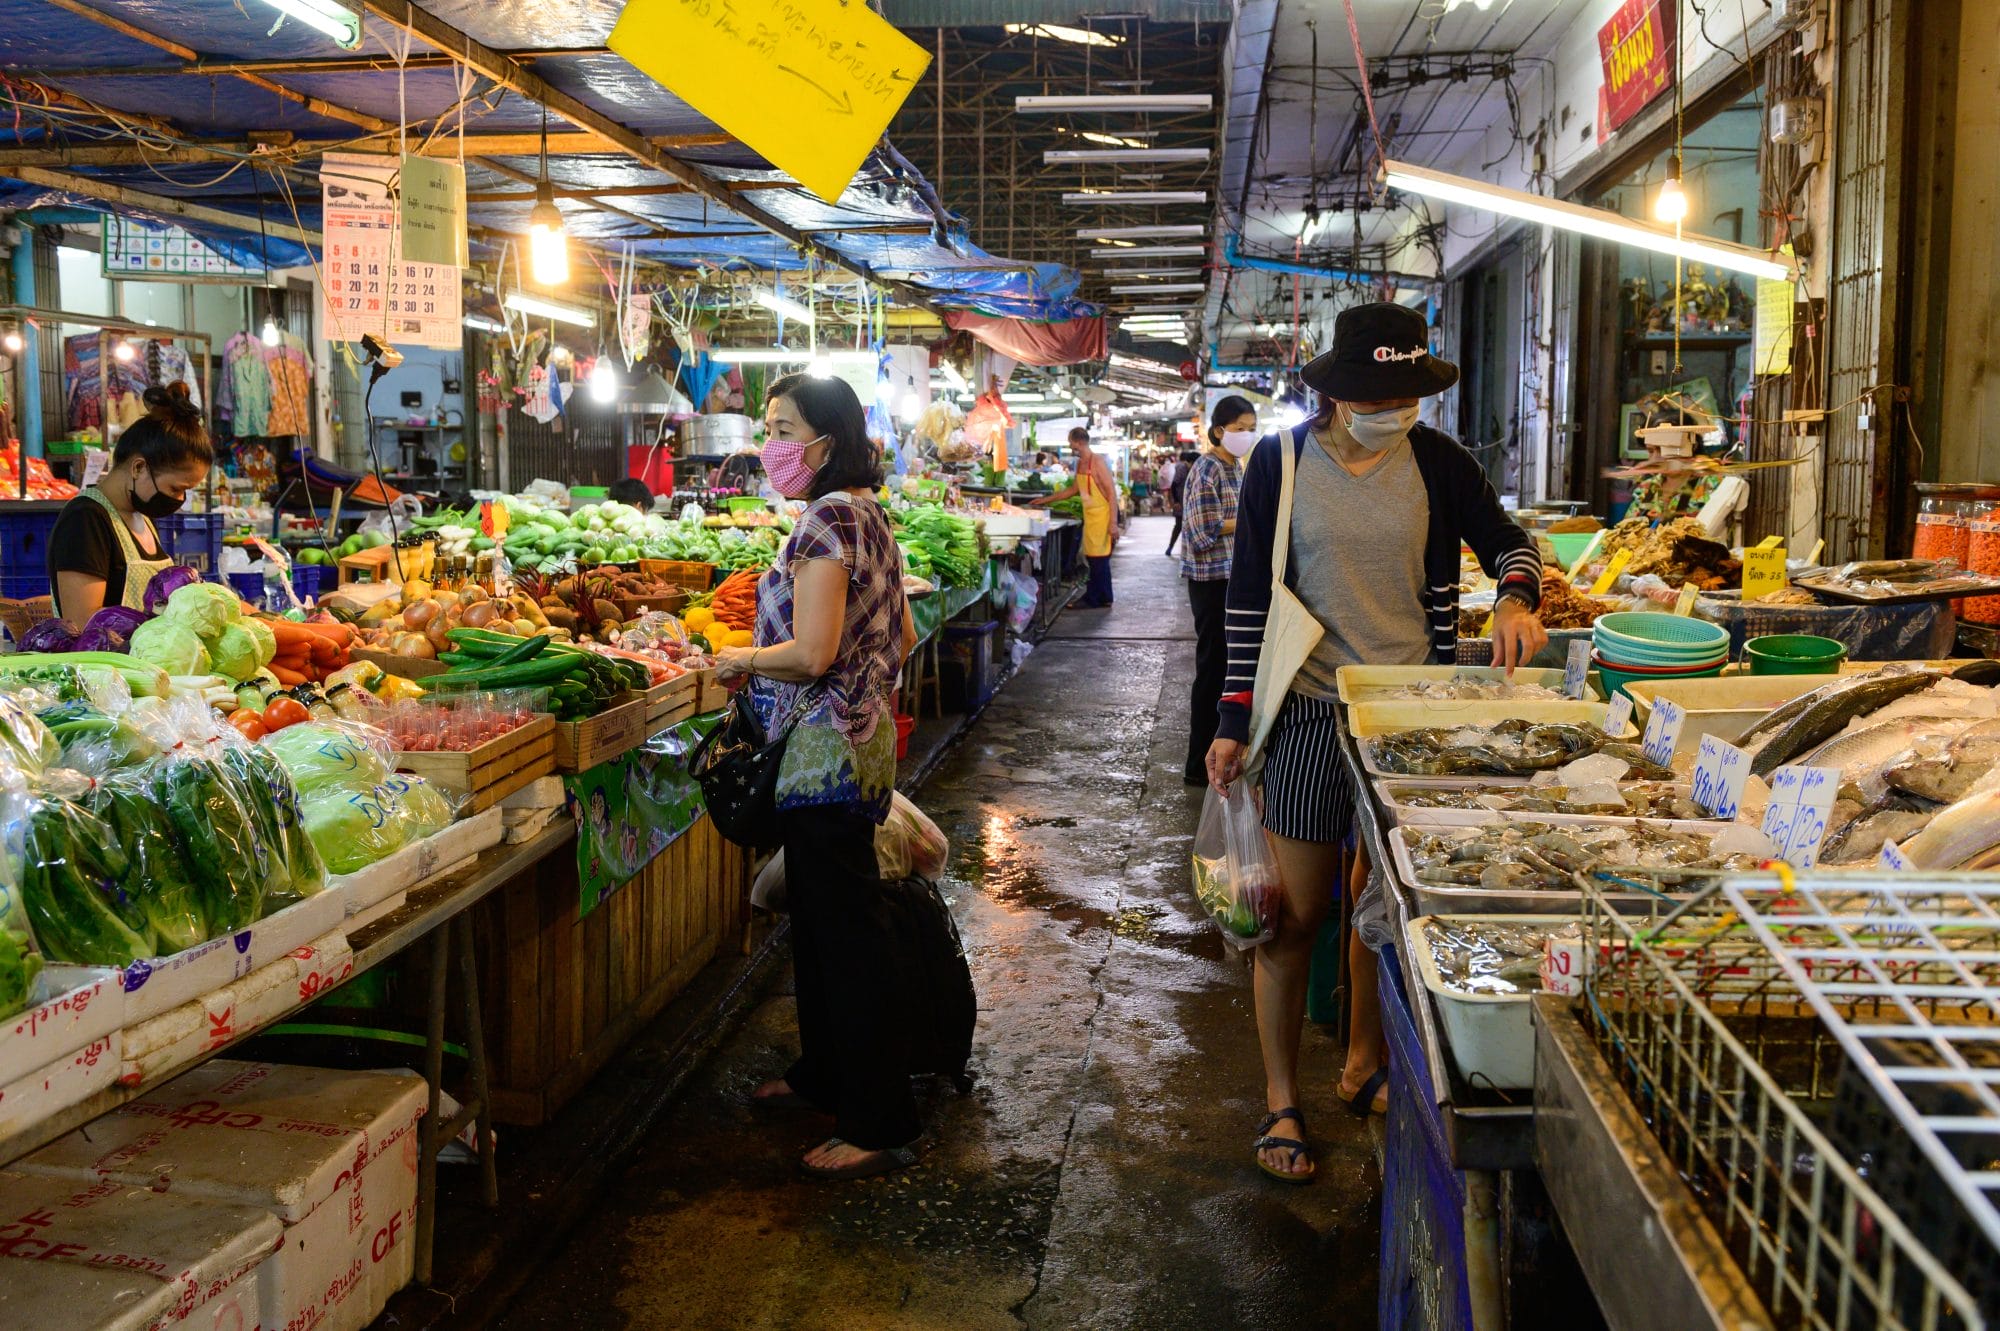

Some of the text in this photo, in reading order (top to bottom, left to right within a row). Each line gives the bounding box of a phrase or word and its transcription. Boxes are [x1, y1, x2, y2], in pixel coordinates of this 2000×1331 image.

[333, 244, 340, 257] 5
[332, 262, 342, 274] 12
[350, 263, 360, 275] 13
[368, 264, 379, 276] 14
[406, 266, 416, 278] 16
[424, 267, 434, 279] 17
[331, 279, 342, 291] 19
[349, 280, 361, 292] 20
[368, 281, 379, 293] 21
[405, 283, 417, 295] 23
[423, 284, 435, 296] 24
[331, 297, 343, 309] 26
[349, 298, 361, 310] 27
[367, 299, 380, 311] 28
[404, 300, 417, 313] 30
[424, 302, 435, 313] 31
[371, 1210, 402, 1264] CF
